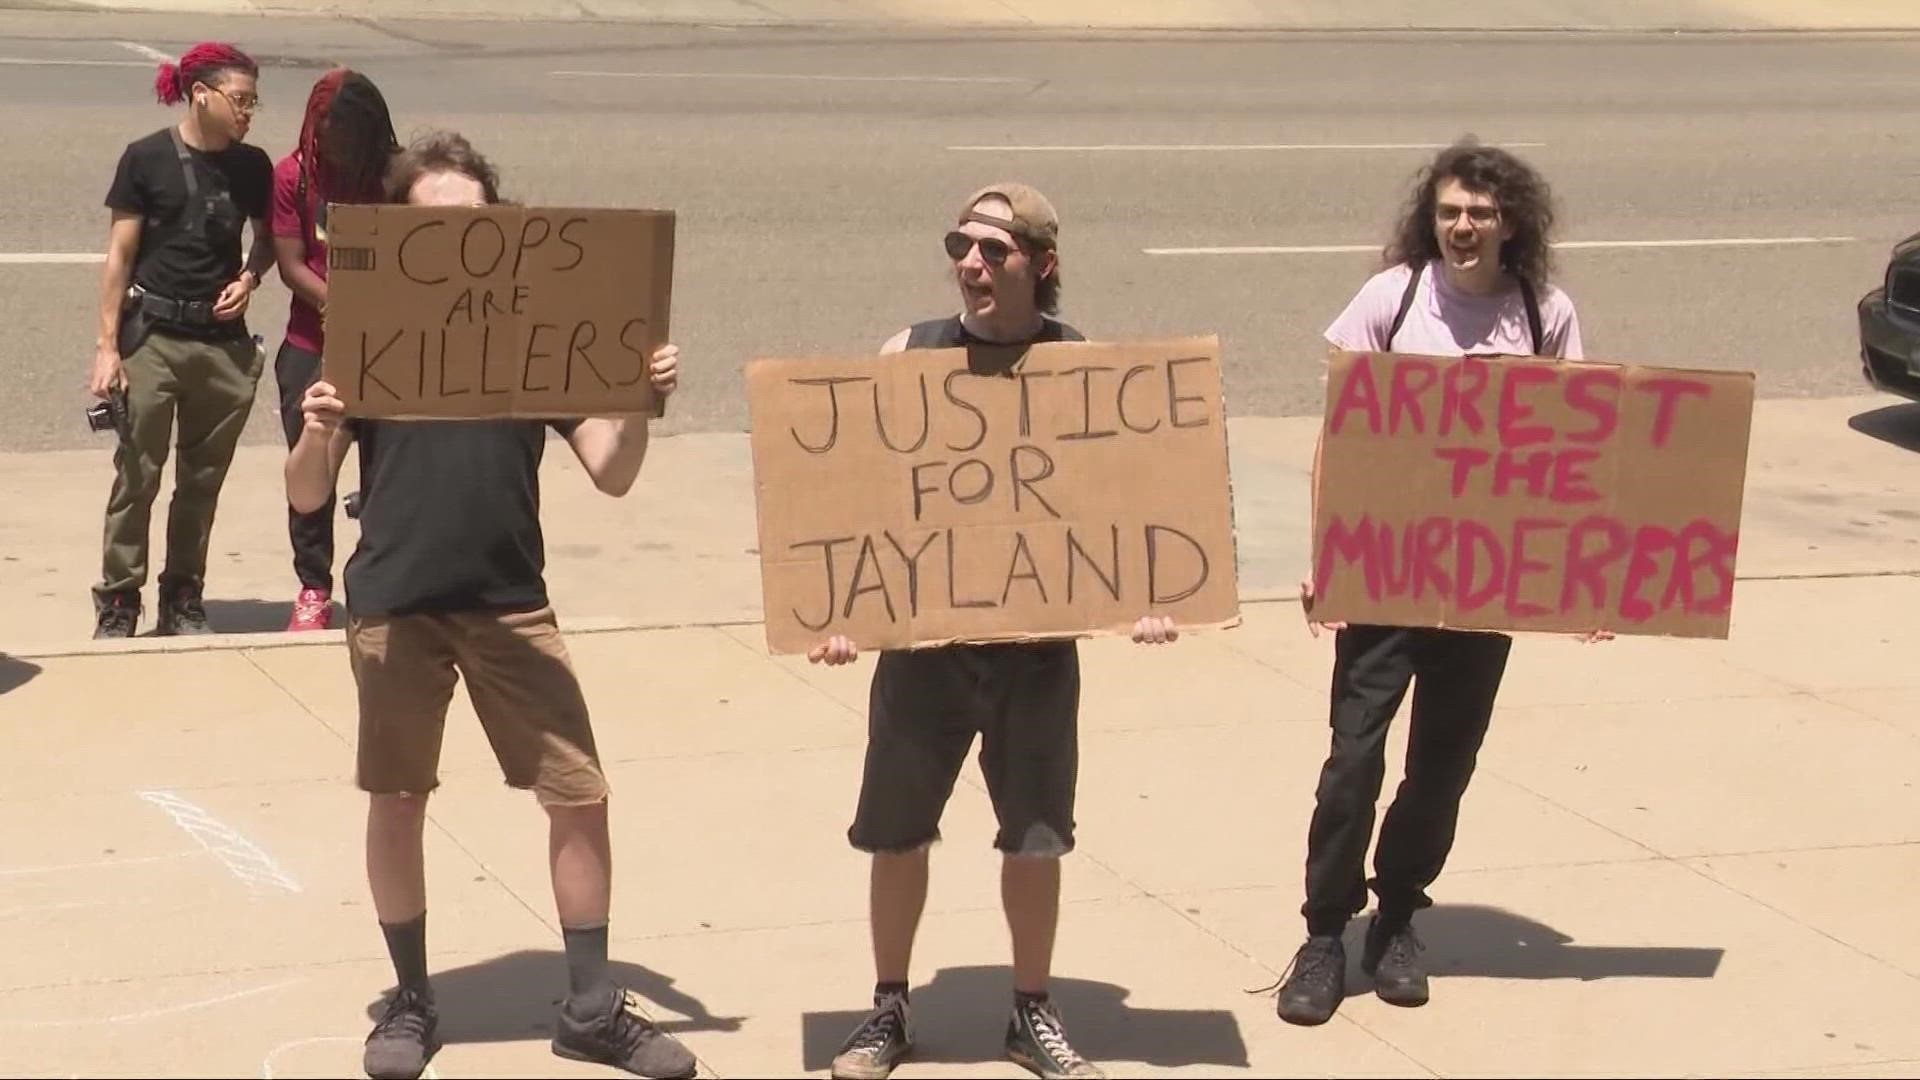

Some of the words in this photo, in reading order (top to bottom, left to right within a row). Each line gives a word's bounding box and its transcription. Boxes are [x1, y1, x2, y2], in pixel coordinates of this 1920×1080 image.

[398, 217, 588, 284] COPS
[446, 286, 530, 325] ARE
[359, 318, 647, 401] KILLERS
[788, 357, 1211, 453] JUSTICE
[1330, 355, 1711, 449] ARREST
[912, 445, 1061, 521] FOR
[1433, 447, 1602, 503] THE
[789, 524, 1209, 632] JAYLAND
[1315, 513, 1739, 623] MURDERERS
